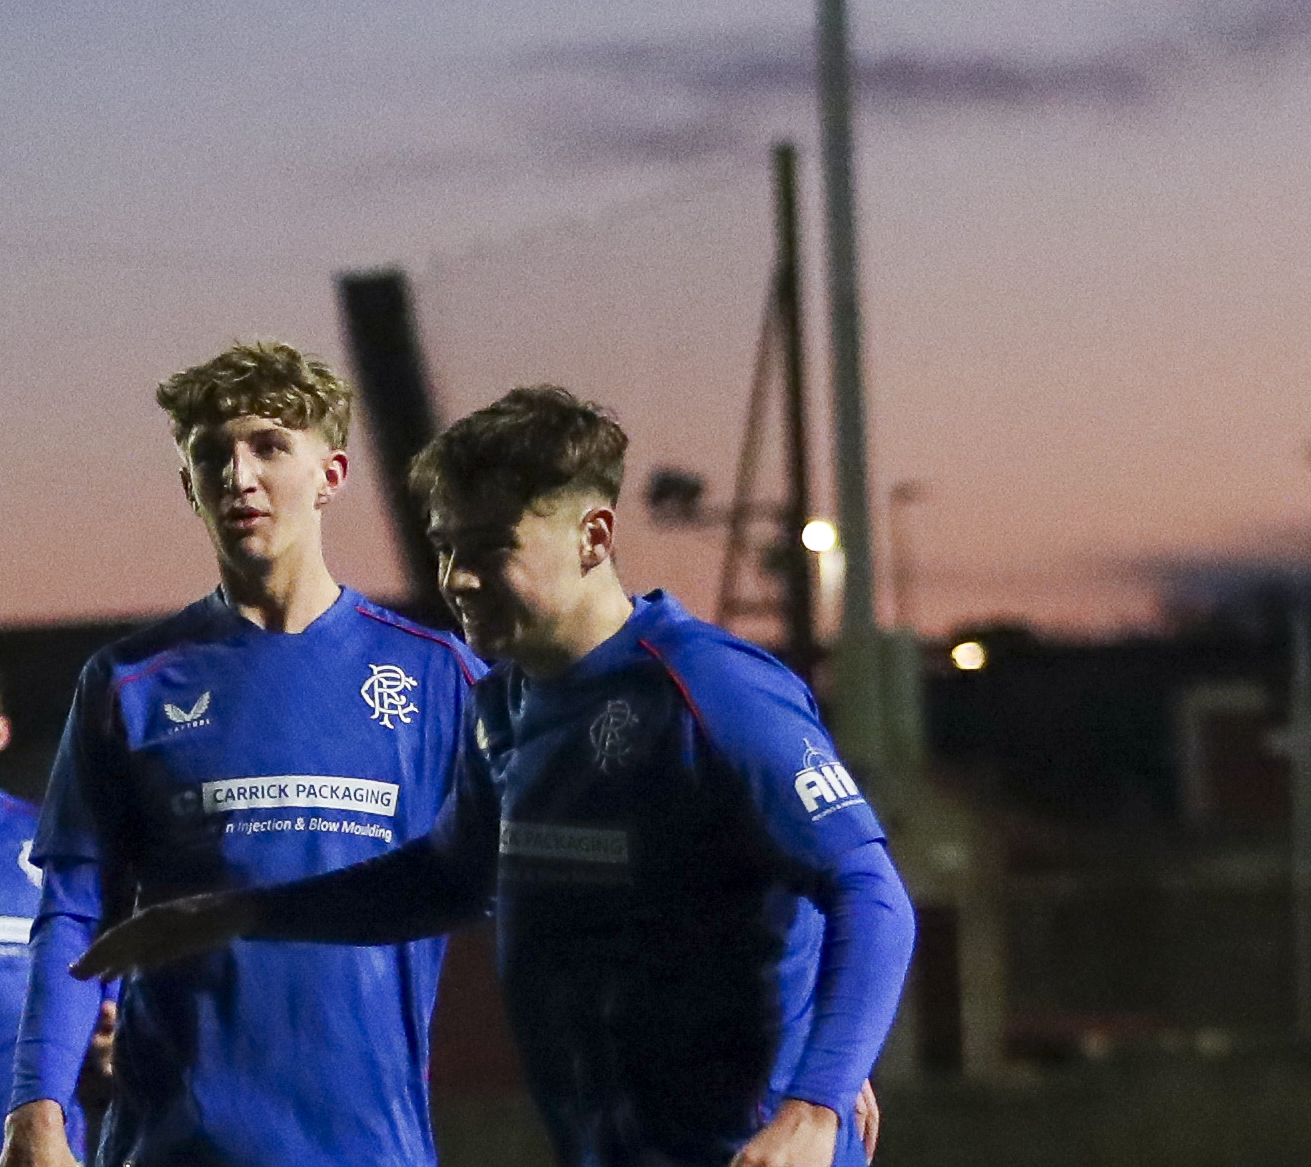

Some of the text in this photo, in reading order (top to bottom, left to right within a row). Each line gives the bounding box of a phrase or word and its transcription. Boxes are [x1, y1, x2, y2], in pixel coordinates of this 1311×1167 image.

[213, 784, 392, 807] CARRICK PACKAGING
[237, 818, 292, 835] Injection
[294, 817, 306, 831] &
[309, 817, 340, 832] Blow
[341, 821, 393, 843] Moulding
